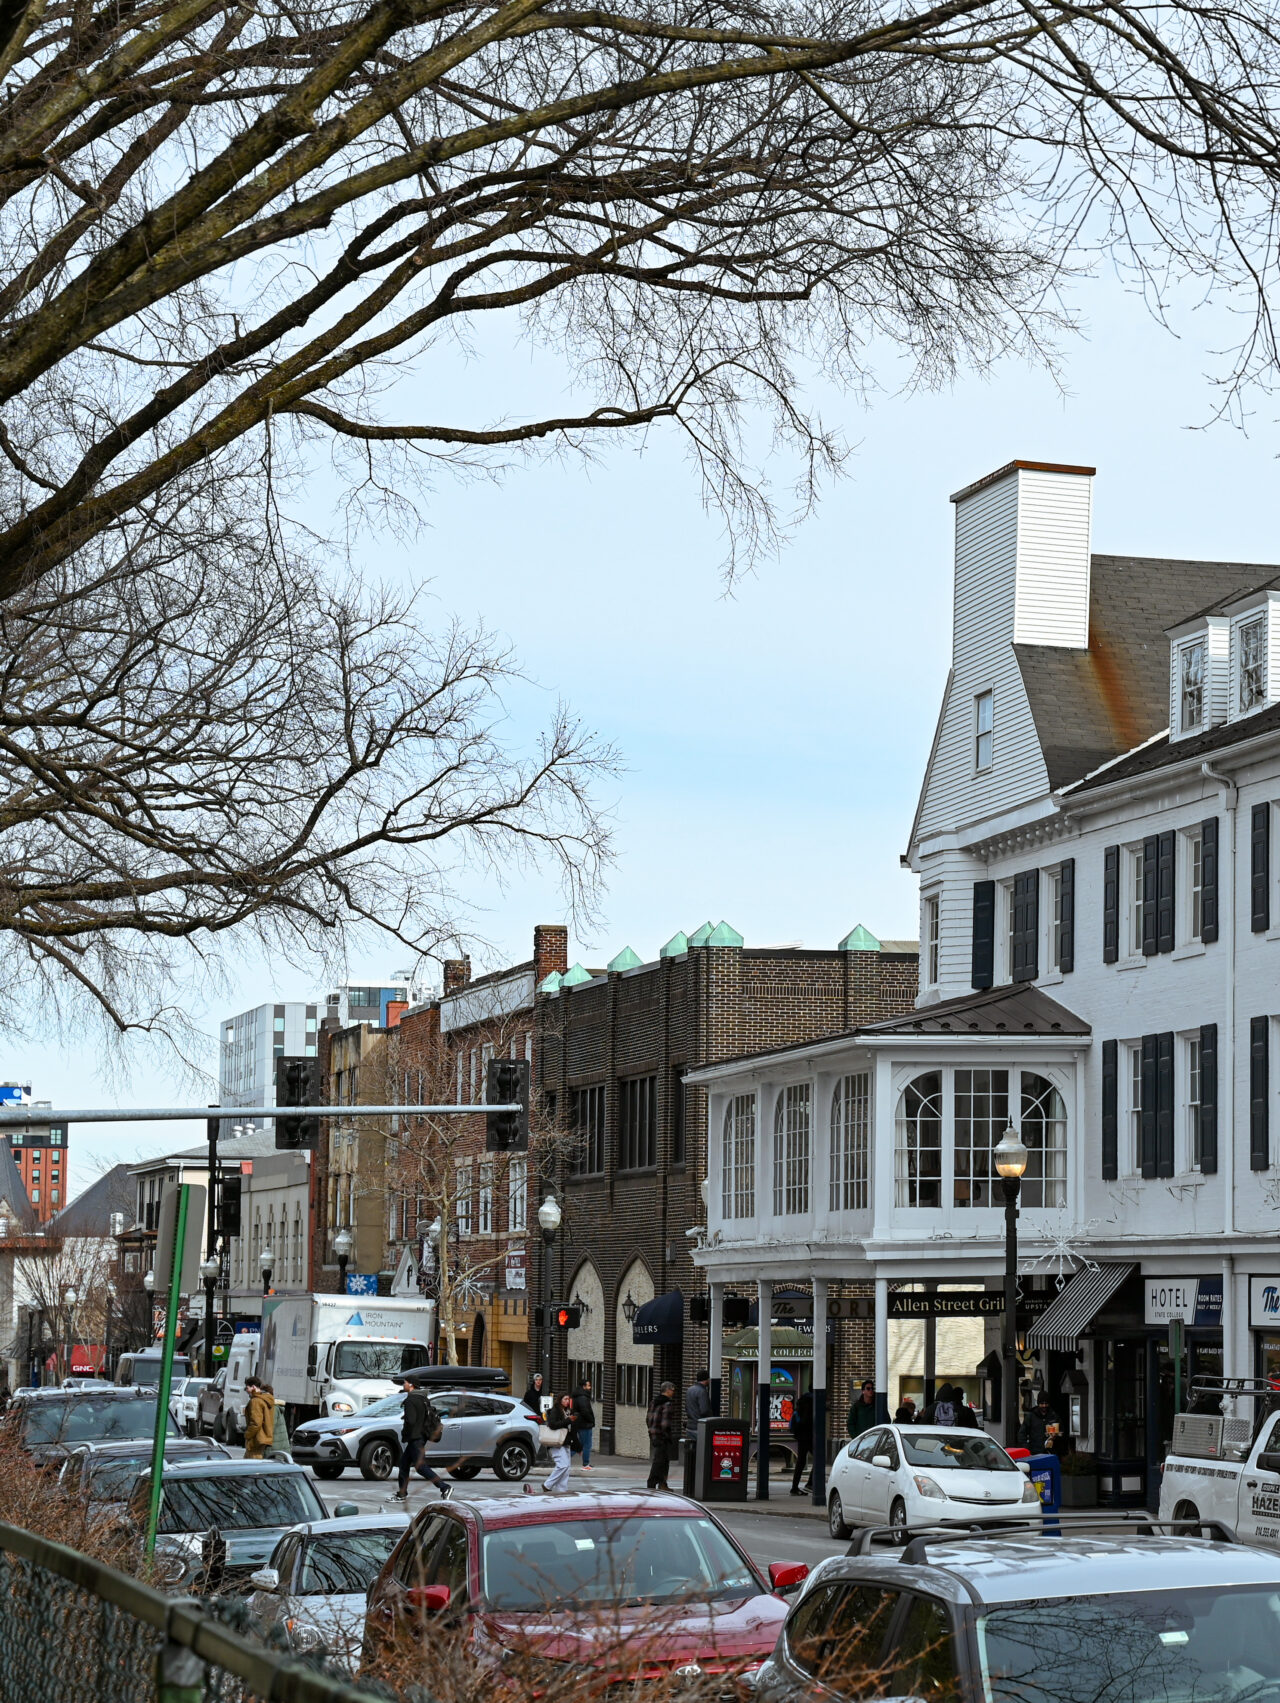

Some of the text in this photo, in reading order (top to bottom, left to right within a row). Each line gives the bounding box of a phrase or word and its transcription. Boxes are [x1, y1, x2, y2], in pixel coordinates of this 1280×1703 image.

[1152, 1288, 1187, 1307] HOTEL
[1262, 1286, 1280, 1313] The
[772, 1302, 795, 1314] The
[893, 1298, 1005, 1311] Allen Street Gril
[365, 1320, 401, 1328] MOUNTAIN
[742, 1348, 760, 1356] STA
